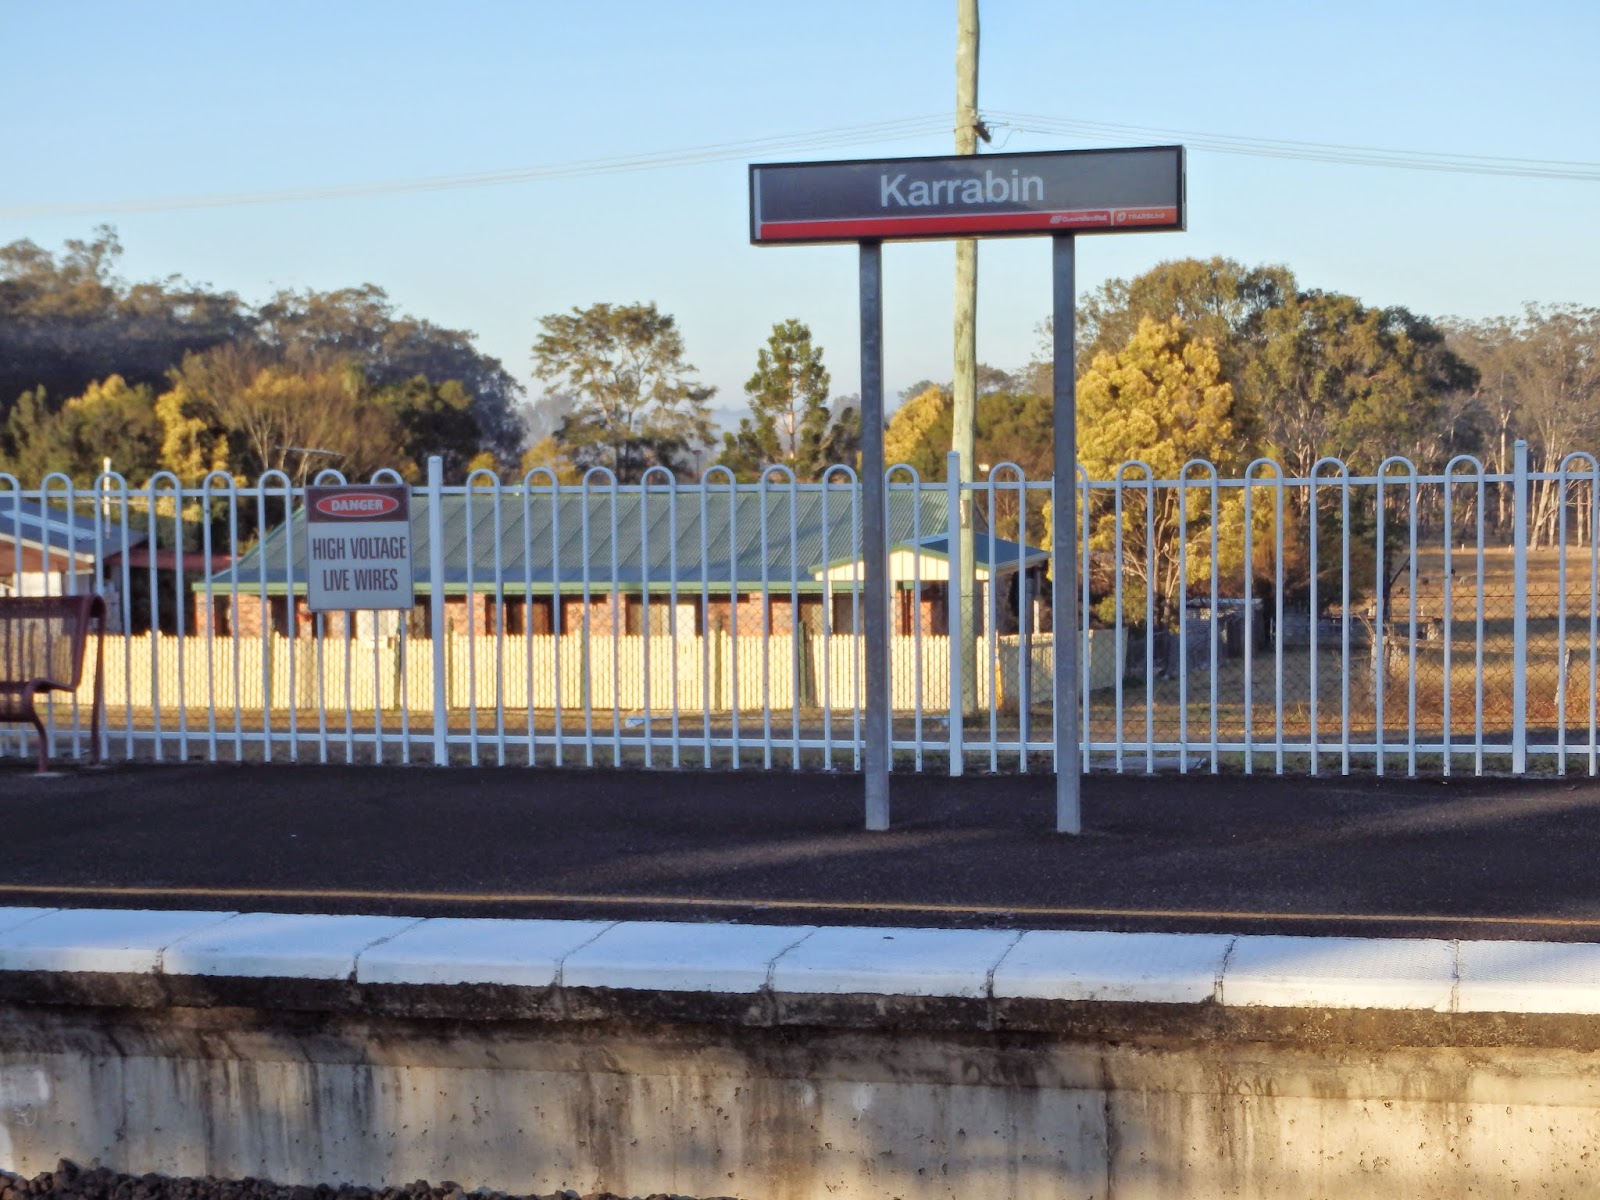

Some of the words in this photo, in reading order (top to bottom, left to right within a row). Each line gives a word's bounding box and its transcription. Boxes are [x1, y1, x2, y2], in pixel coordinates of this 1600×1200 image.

[880, 169, 1044, 207] Karrabin
[331, 499, 384, 511] DANGER
[313, 538, 345, 560] HIGH
[350, 537, 407, 559] VOLTAGE
[323, 569, 350, 591] LIVE
[354, 568, 398, 591] WIRES
